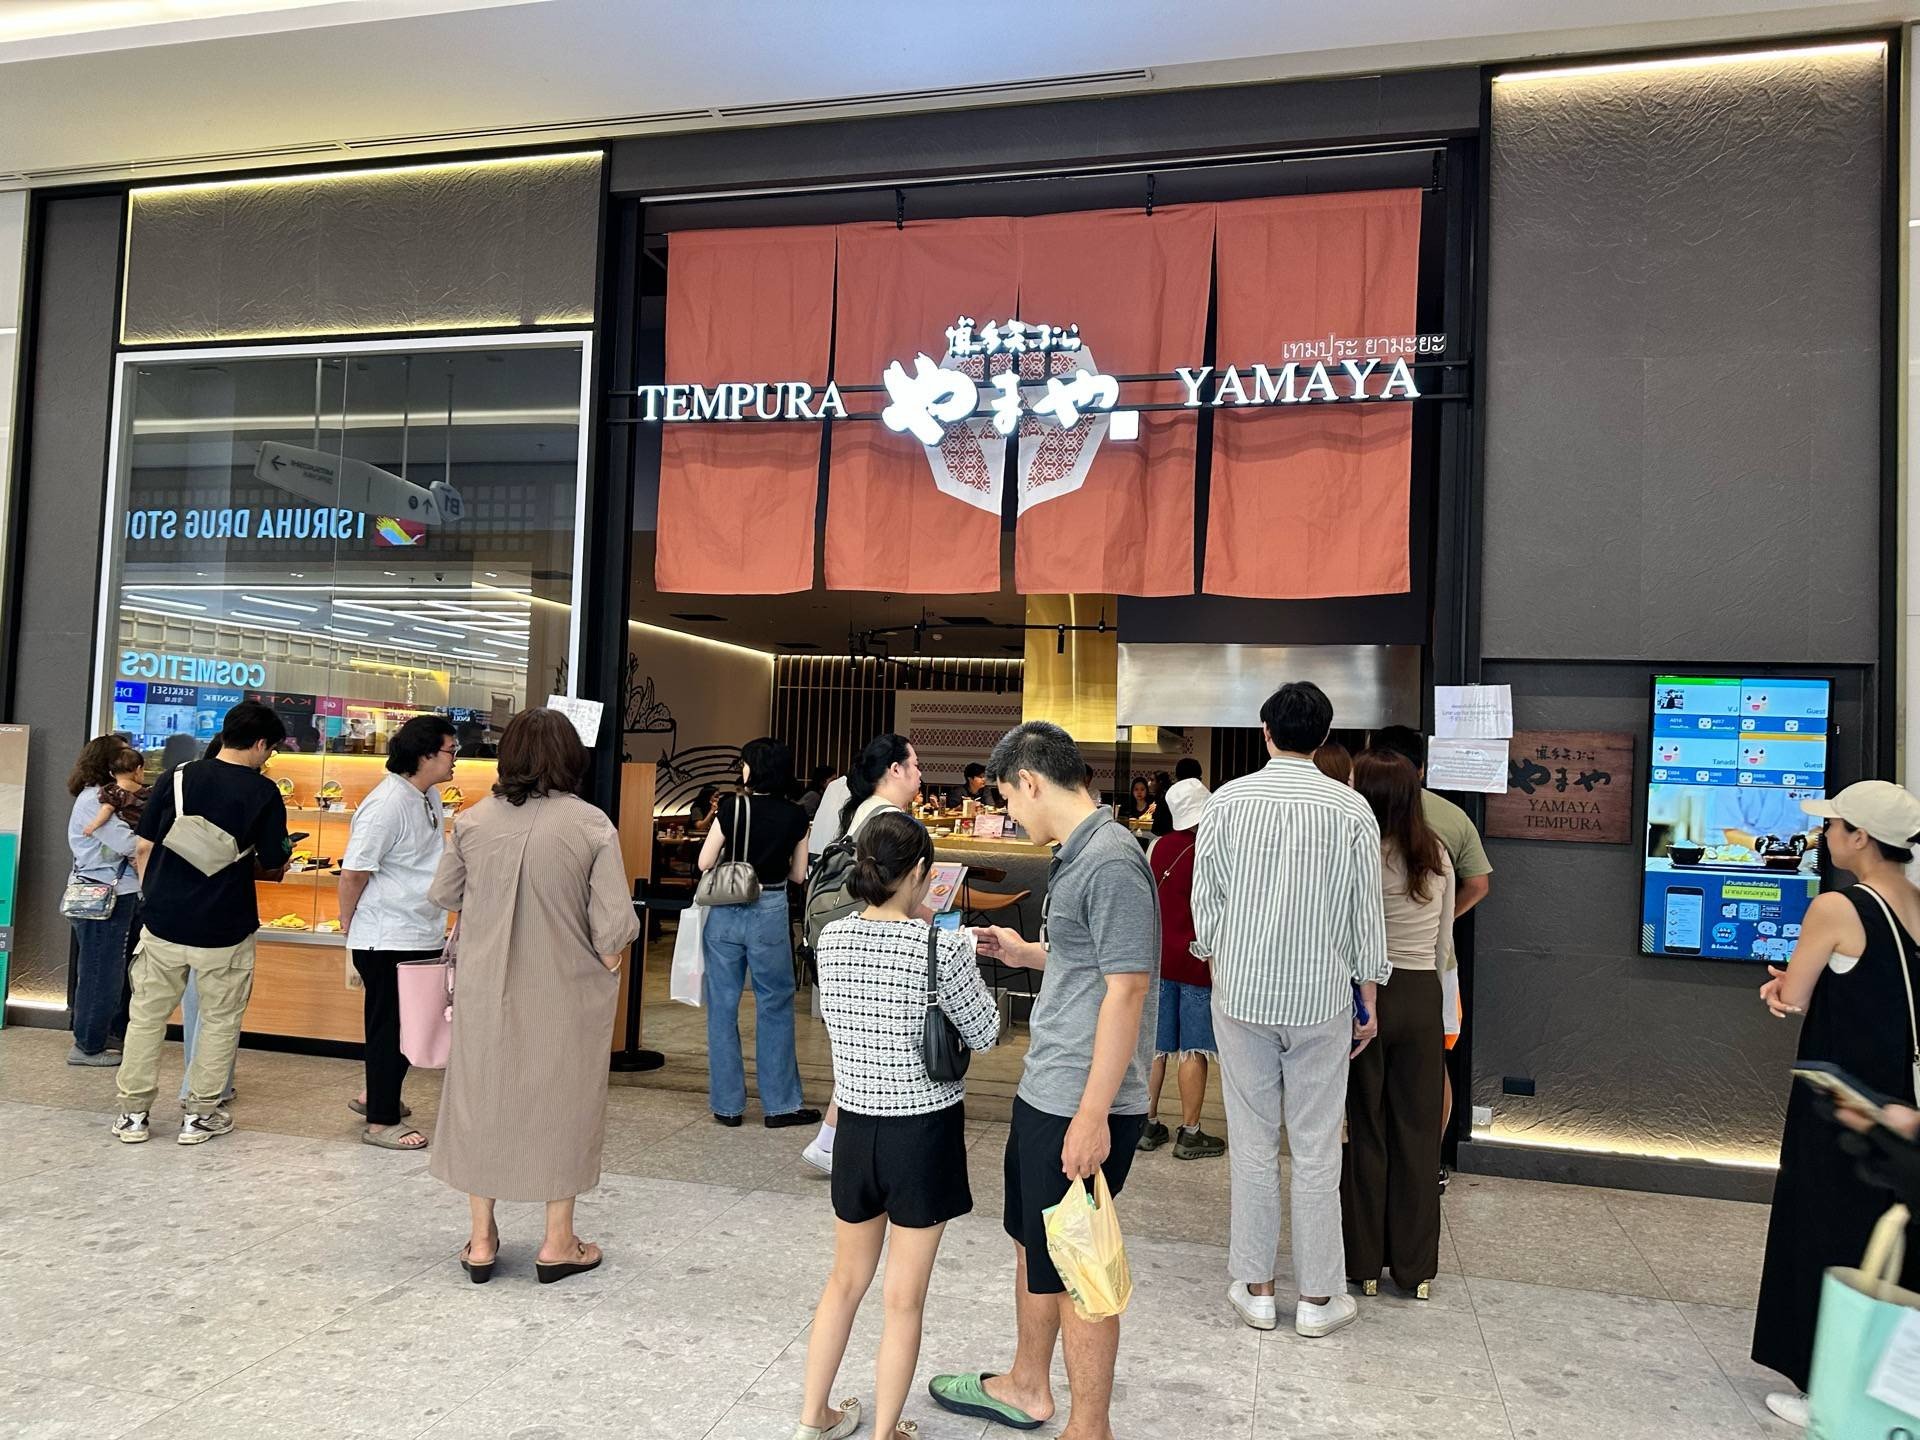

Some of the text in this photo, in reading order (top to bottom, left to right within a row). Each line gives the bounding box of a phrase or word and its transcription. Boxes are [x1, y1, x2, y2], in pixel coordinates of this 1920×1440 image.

[1283, 334, 1445, 366] เทมปุระ ยามะยะ
[881, 352, 1119, 447] やまや
[1175, 357, 1421, 406] YAMAYA
[637, 380, 849, 421] TEMPURA
[1508, 758, 1611, 794] やまや
[1523, 815, 1602, 830] TEMPURA
[1528, 799, 1601, 814] YAMAYA
